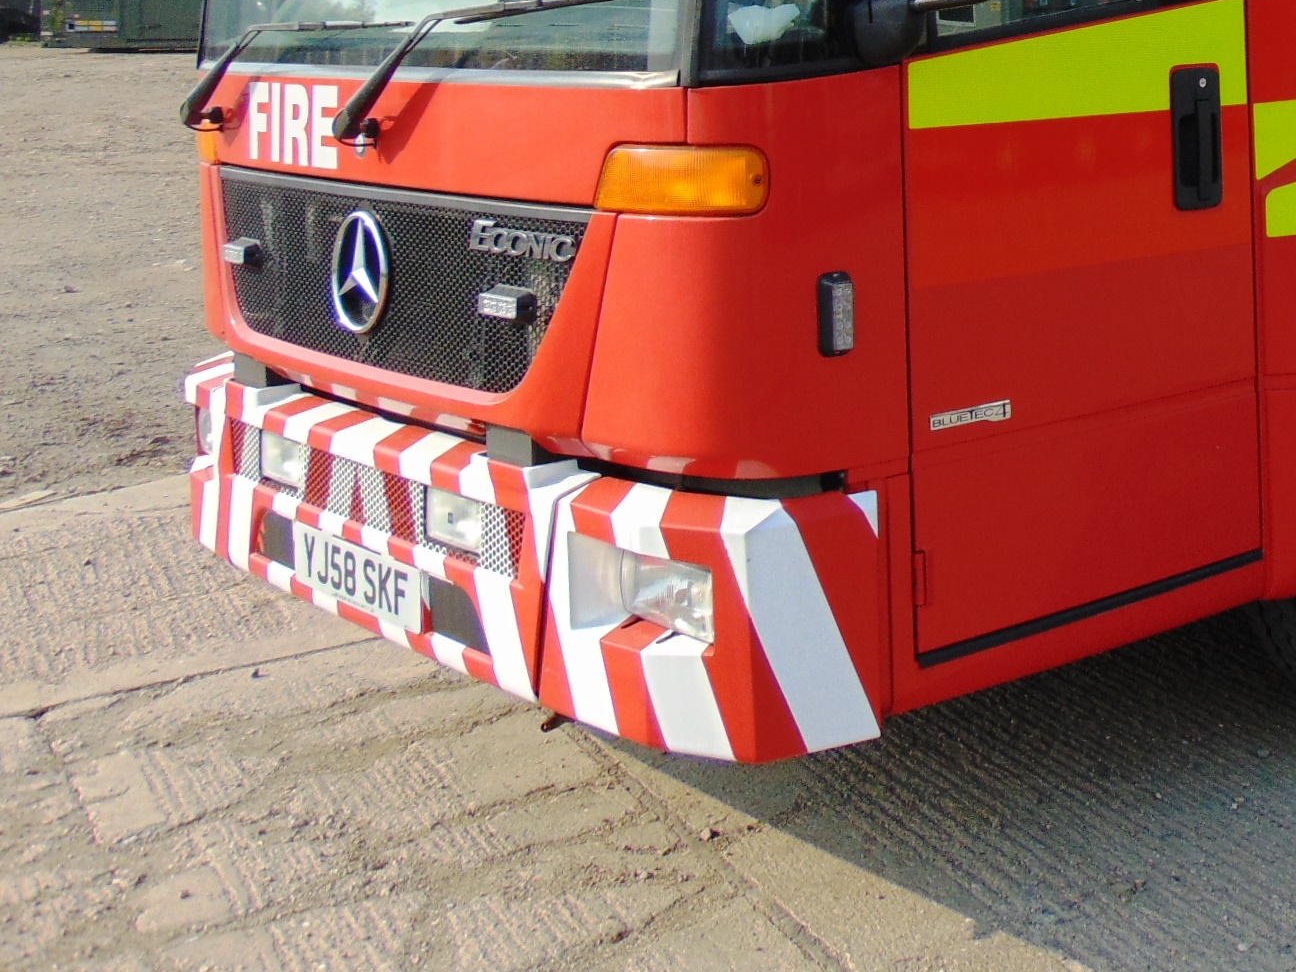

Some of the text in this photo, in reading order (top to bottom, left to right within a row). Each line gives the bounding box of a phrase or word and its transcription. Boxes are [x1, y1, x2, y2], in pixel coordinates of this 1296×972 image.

[249, 81, 338, 170] FIRE
[470, 219, 576, 262] ECONIC
[304, 533, 408, 616] YJ58 SKF
